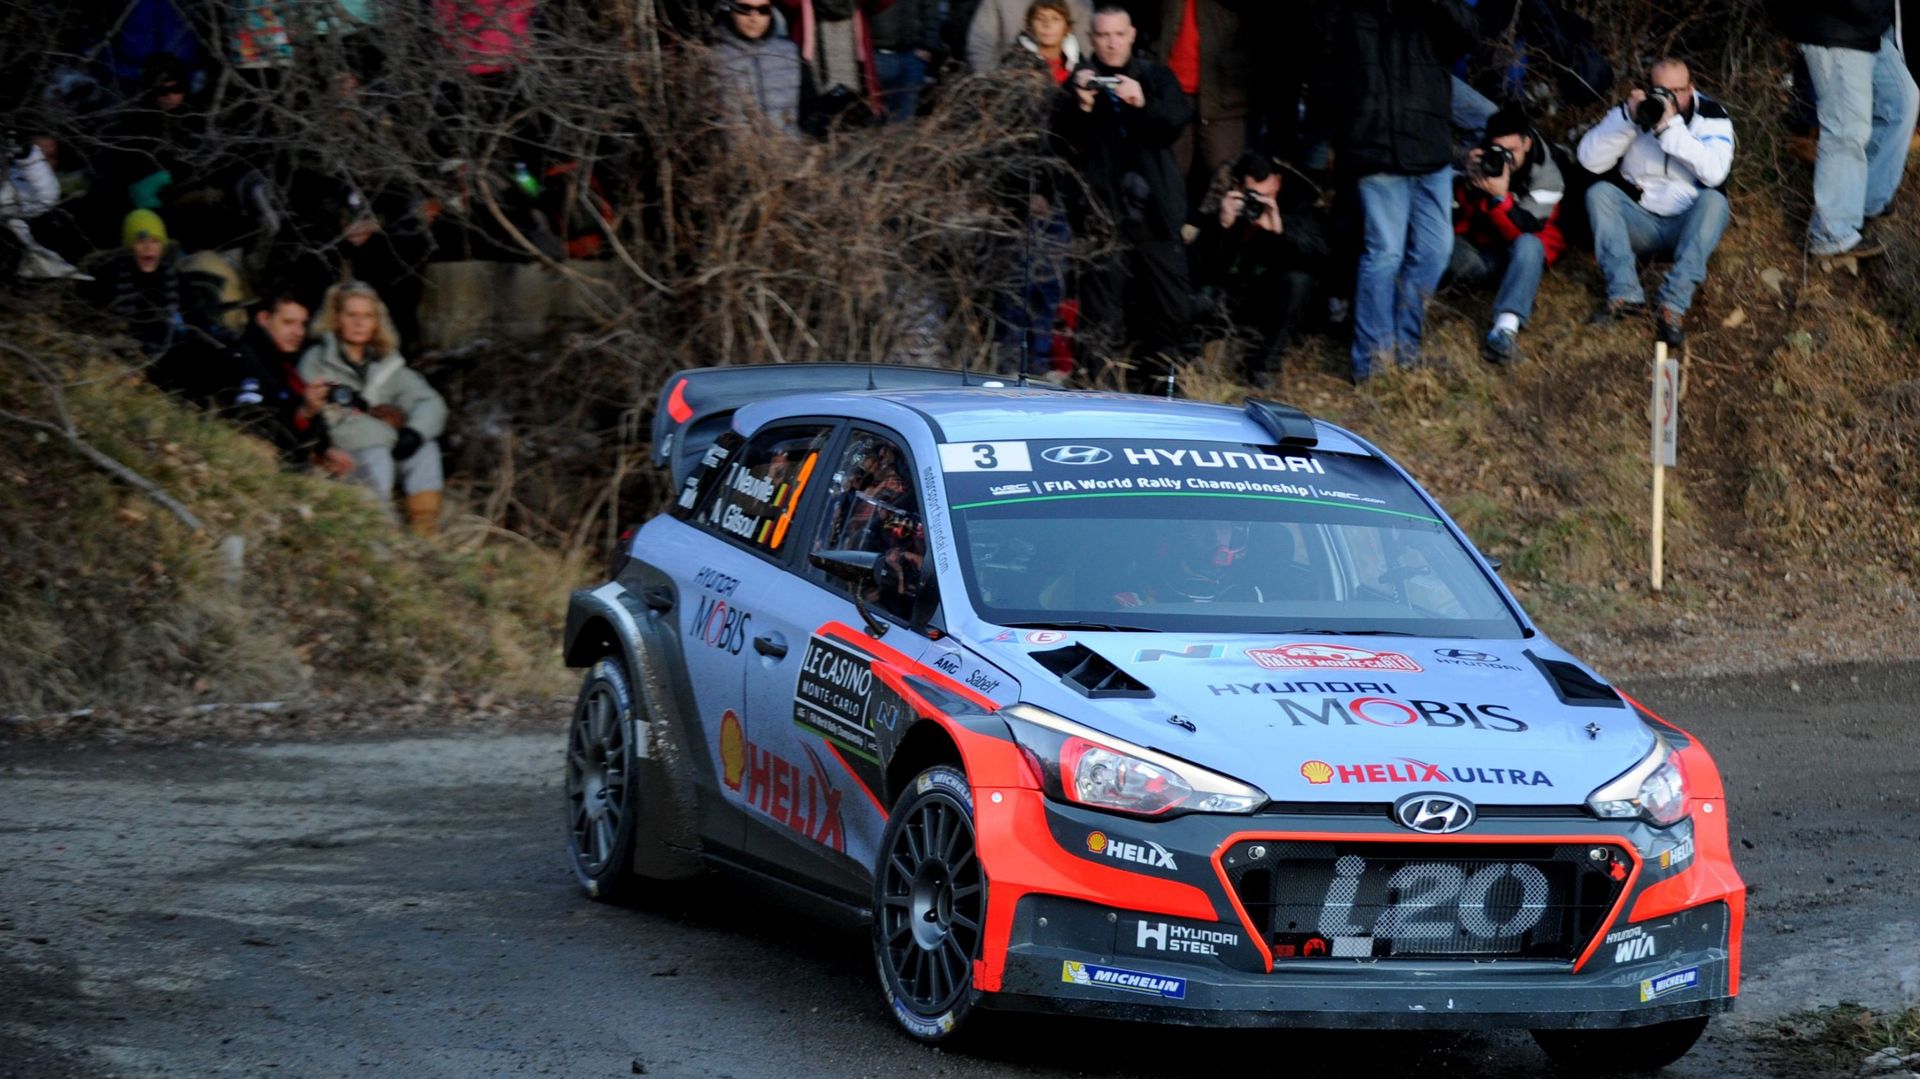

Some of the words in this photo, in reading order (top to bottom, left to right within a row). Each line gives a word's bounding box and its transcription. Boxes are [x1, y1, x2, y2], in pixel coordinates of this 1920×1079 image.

[974, 444, 998, 469] 3
[1123, 447, 1326, 475] HYUNDAI
[1044, 480, 1077, 491] FIA
[1078, 478, 1133, 490] World
[1136, 477, 1182, 491] Rally
[1186, 478, 1309, 497] Championship
[721, 503, 760, 539] Gilsoul
[694, 566, 742, 597] HYUNDAI
[689, 595, 752, 656] MOBIS
[1036, 632, 1055, 642] E
[803, 645, 823, 674] LE
[818, 651, 872, 696] CASINO
[1435, 658, 1523, 672] HYUNDAI
[965, 668, 1000, 694] Sabelt
[1207, 682, 1398, 696] HYUNDAI
[1274, 697, 1529, 733] MOBIS
[1335, 757, 1453, 783] HELIX
[1450, 767, 1555, 788] ULTRA
[747, 740, 845, 854] HELIX
[1106, 840, 1178, 870] HELIX
[1169, 939, 1219, 956] STEEL
[1170, 925, 1238, 946] HYUNDAI
[1605, 926, 1643, 945] HYUNDAI
[1615, 932, 1656, 964] WIA
[1093, 969, 1181, 993] MICHELIN
[1655, 970, 1697, 992] MICHELIN
